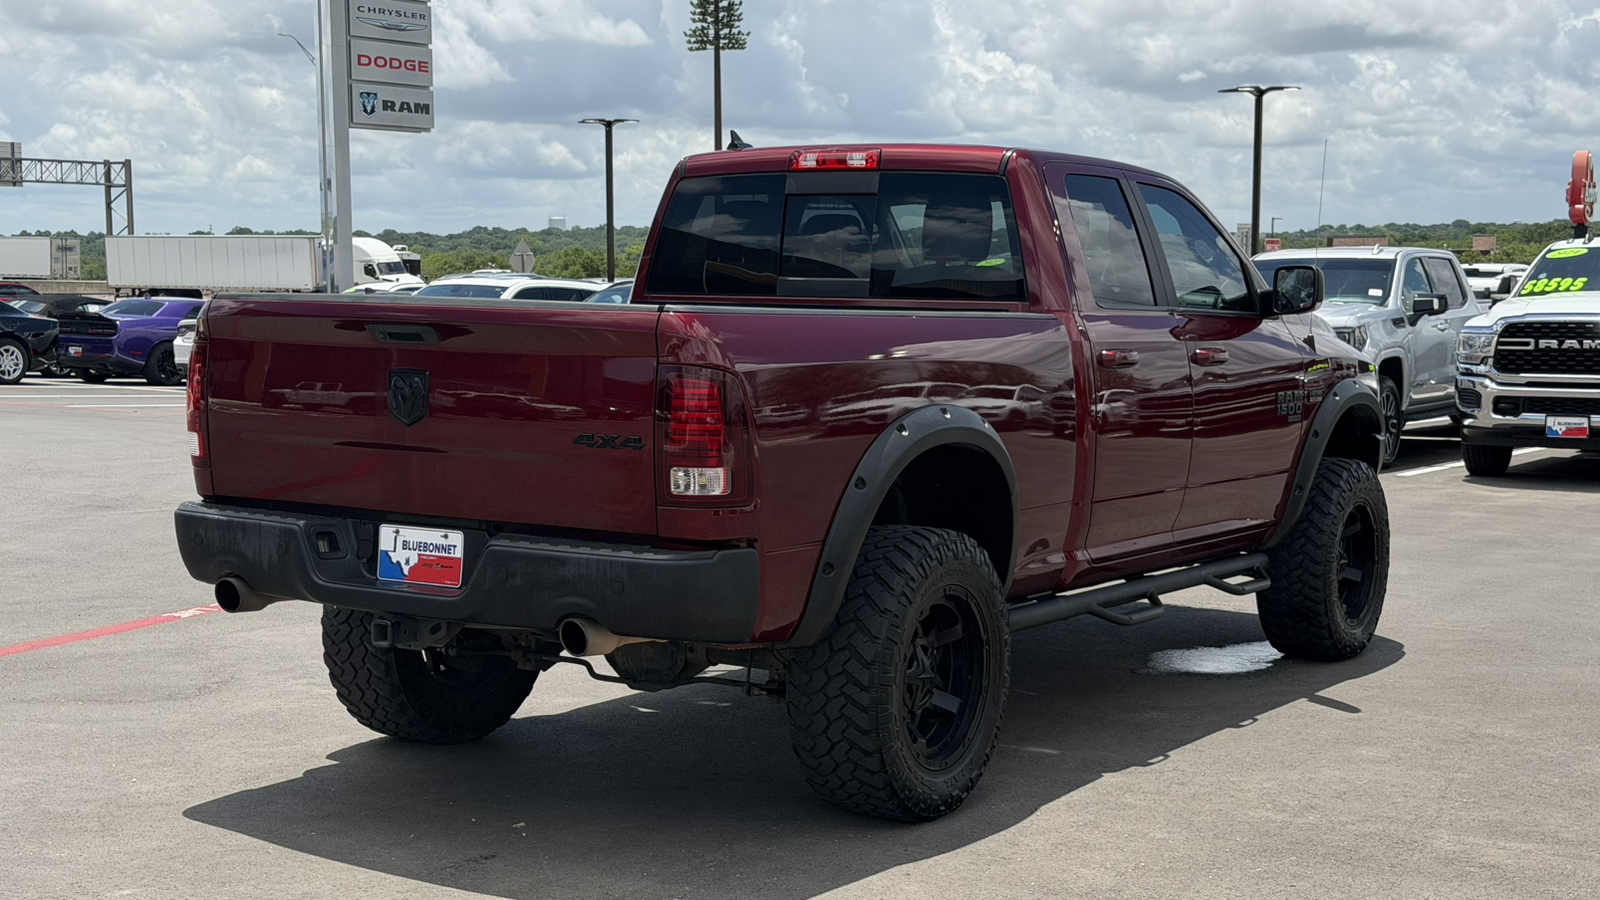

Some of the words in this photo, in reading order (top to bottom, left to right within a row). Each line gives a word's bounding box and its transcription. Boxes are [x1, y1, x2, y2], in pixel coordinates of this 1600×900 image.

[357, 5, 426, 20] CHRYSLER
[357, 54, 429, 73] DODGE
[382, 99, 430, 115] RAM
[1520, 277, 1588, 295] 58595
[1538, 339, 1600, 349] RAM
[1277, 390, 1304, 403] RAM
[1277, 402, 1303, 415] 1500
[402, 540, 457, 555] BLUEBONNET
